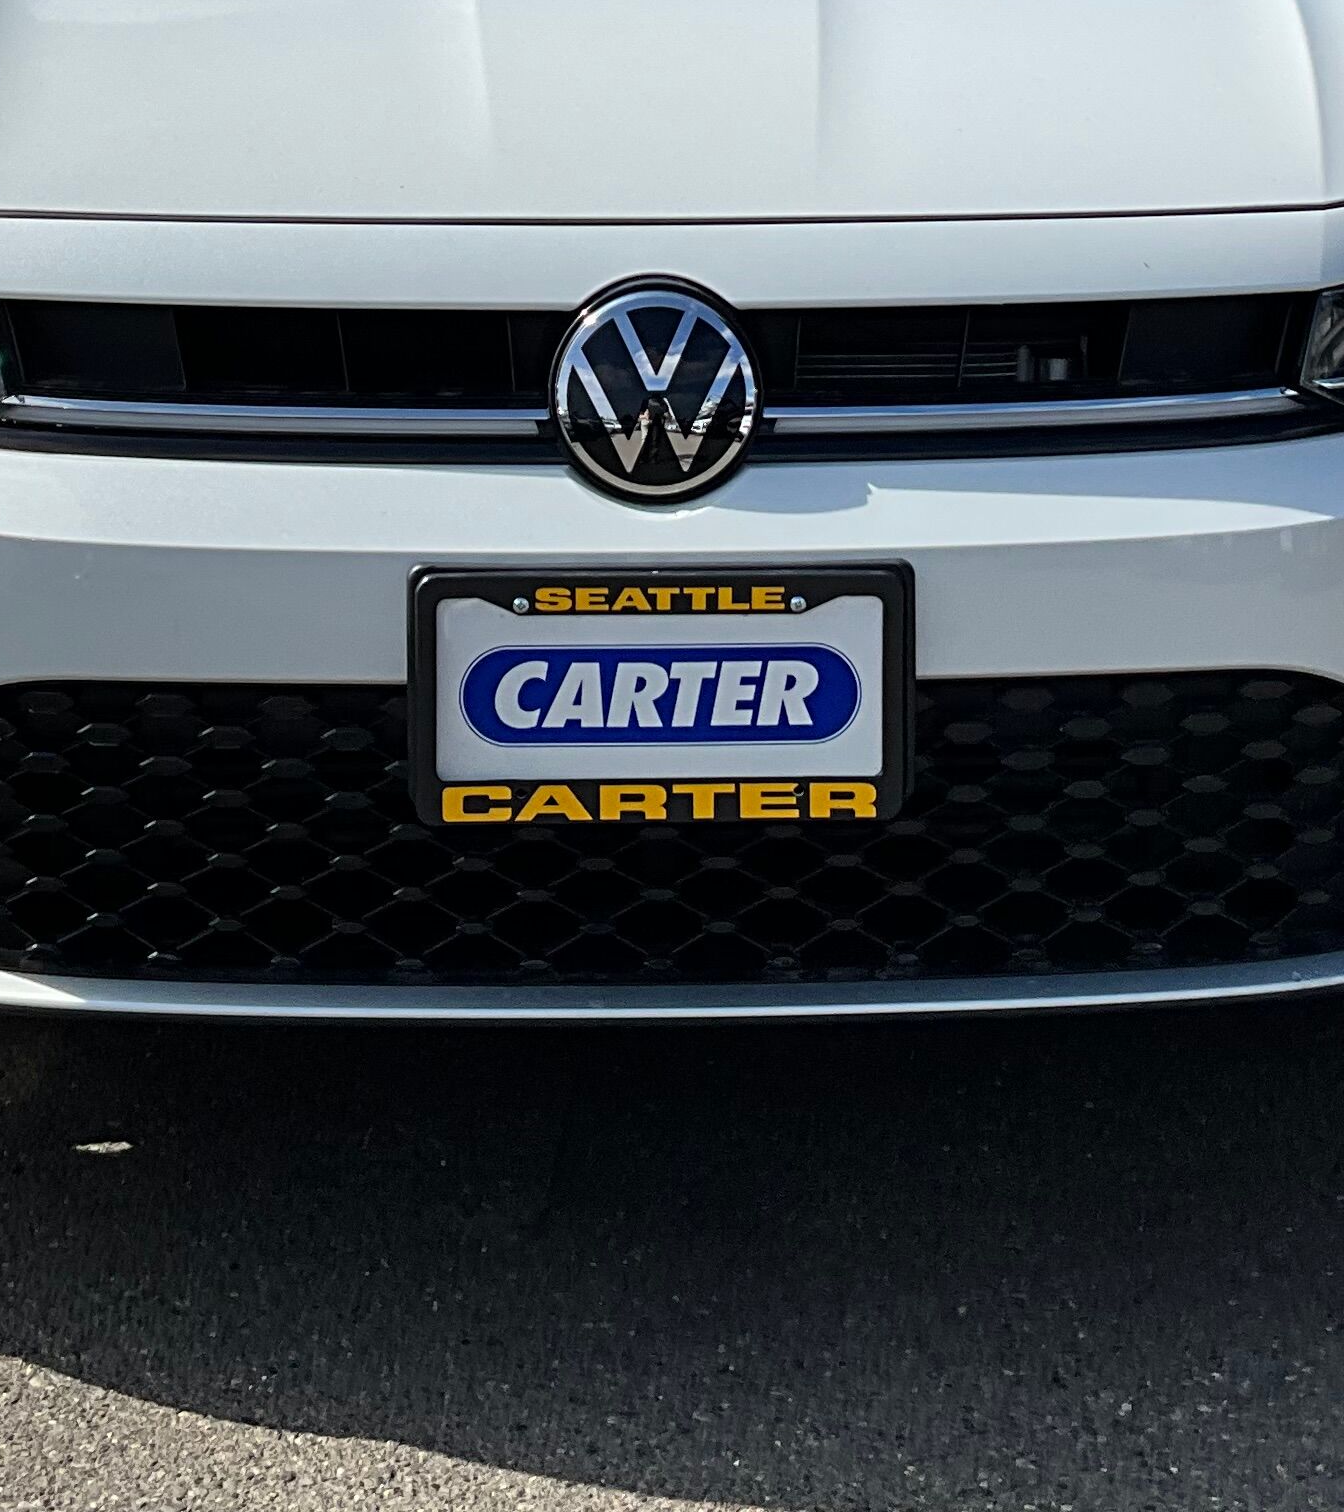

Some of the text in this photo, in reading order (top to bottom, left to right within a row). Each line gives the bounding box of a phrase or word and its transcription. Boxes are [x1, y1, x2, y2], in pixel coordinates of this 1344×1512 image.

[534, 586, 786, 612] SEATTLE
[494, 659, 820, 730] CARTER
[440, 781, 878, 823] CARTER
